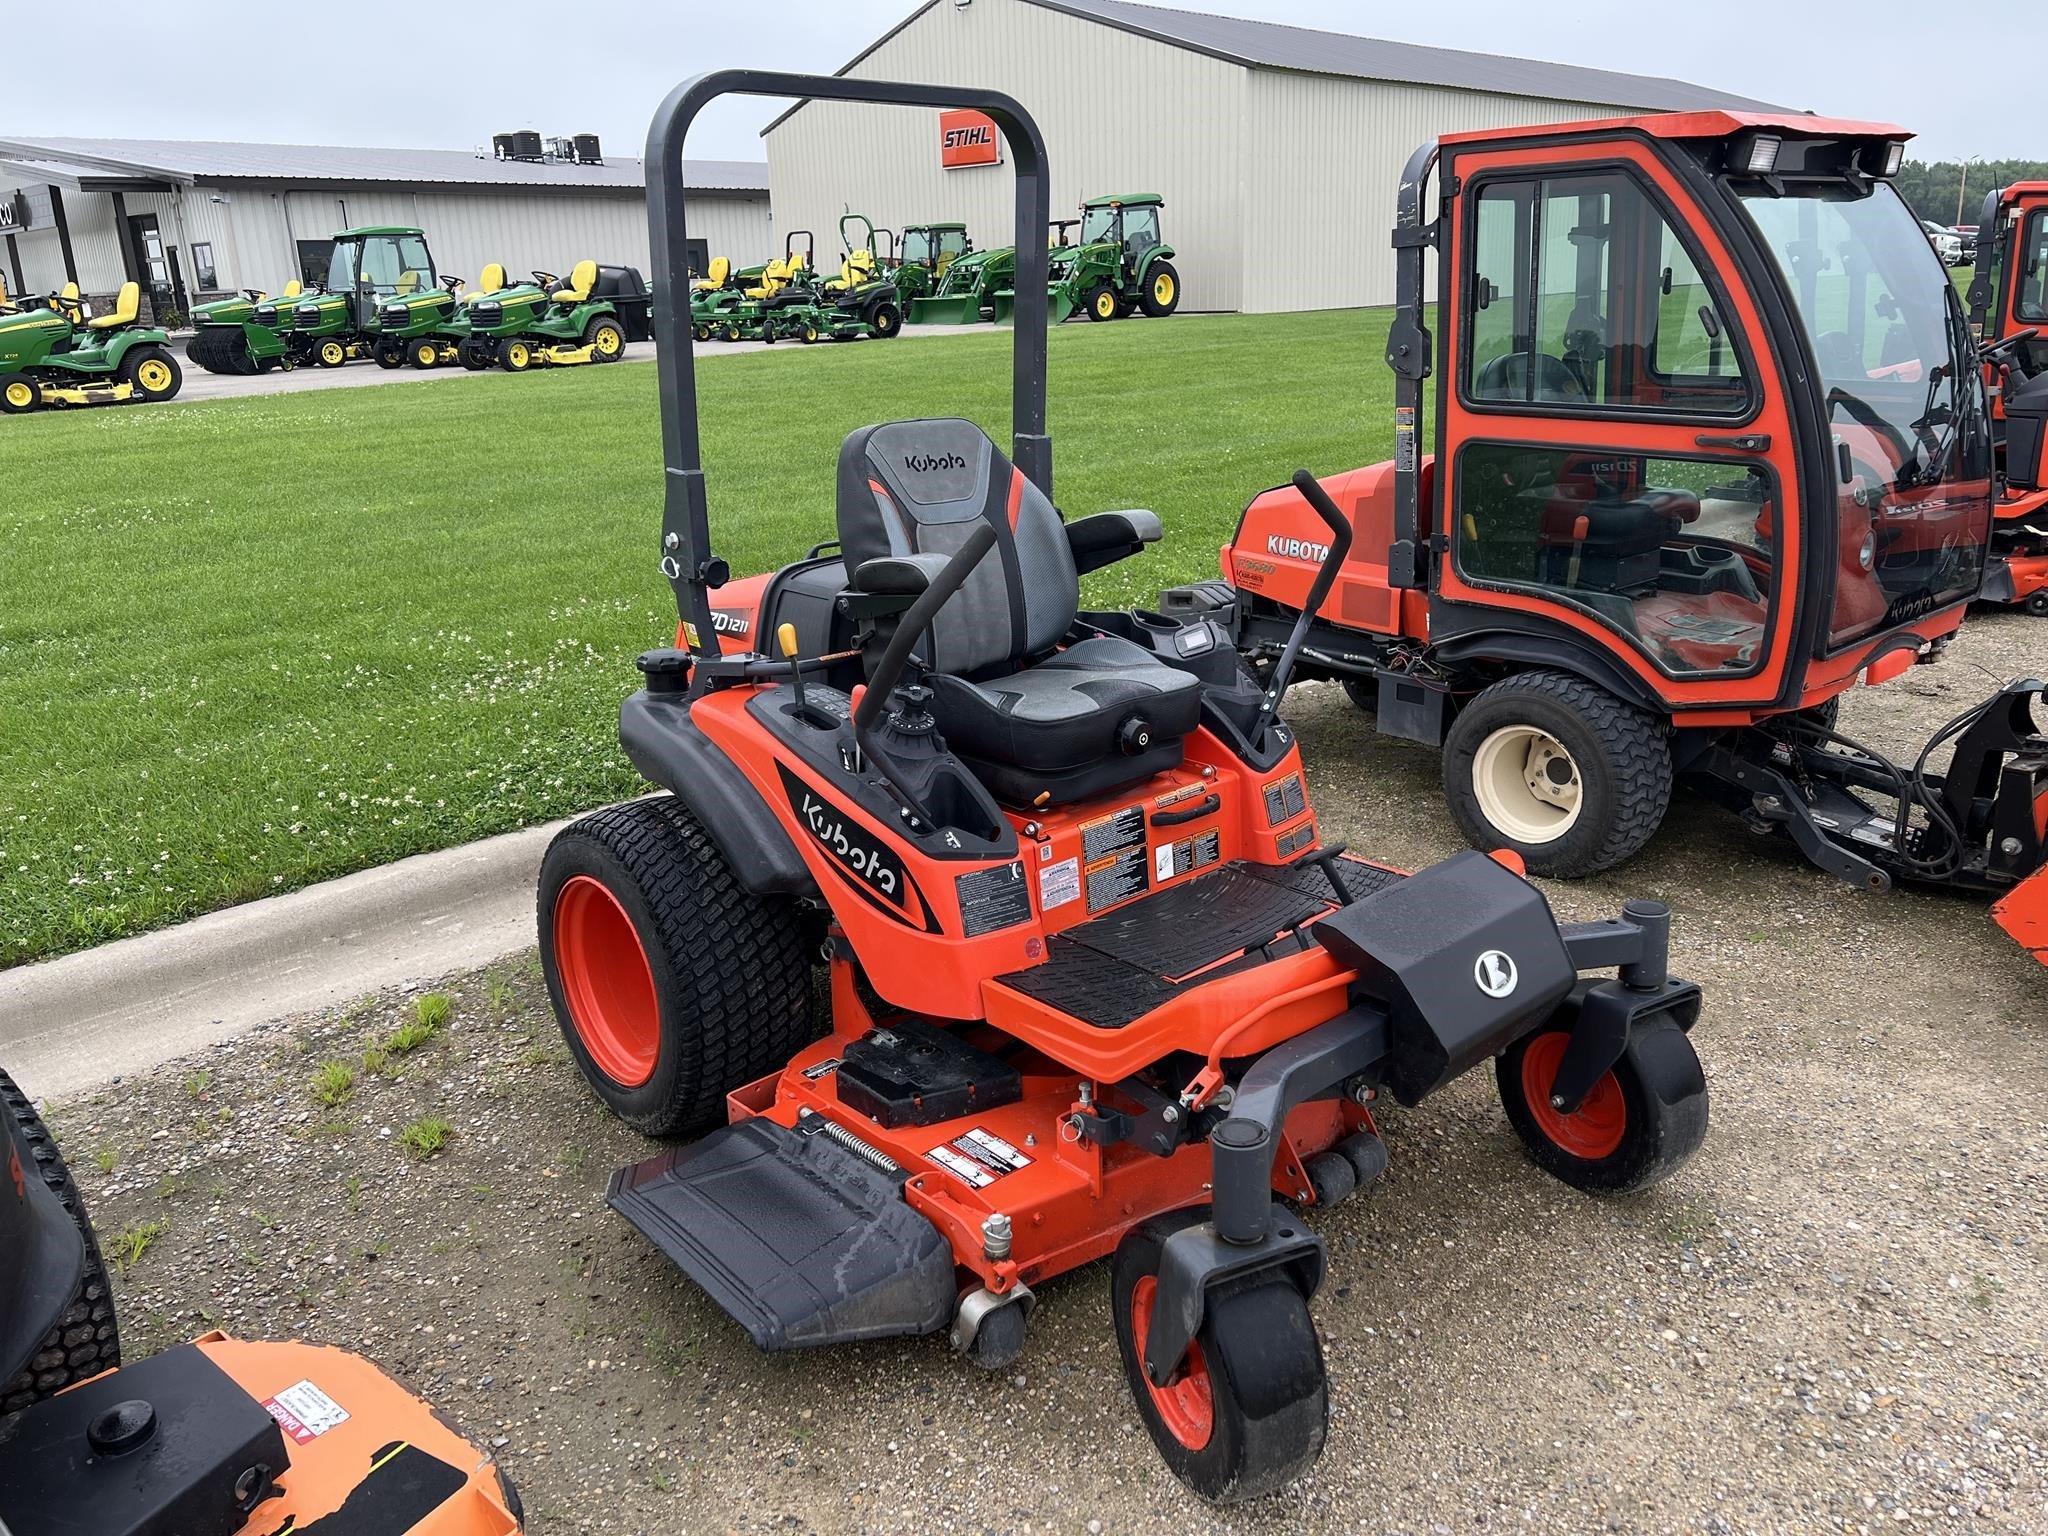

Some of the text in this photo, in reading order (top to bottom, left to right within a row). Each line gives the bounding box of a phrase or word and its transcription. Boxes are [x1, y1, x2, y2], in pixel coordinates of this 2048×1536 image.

[943, 125, 992, 149] STIHL
[904, 452, 966, 473] Kubota
[1266, 534, 1330, 564] KUBOTA
[802, 793, 896, 894] Kubota
[266, 1401, 302, 1431] DANGER
